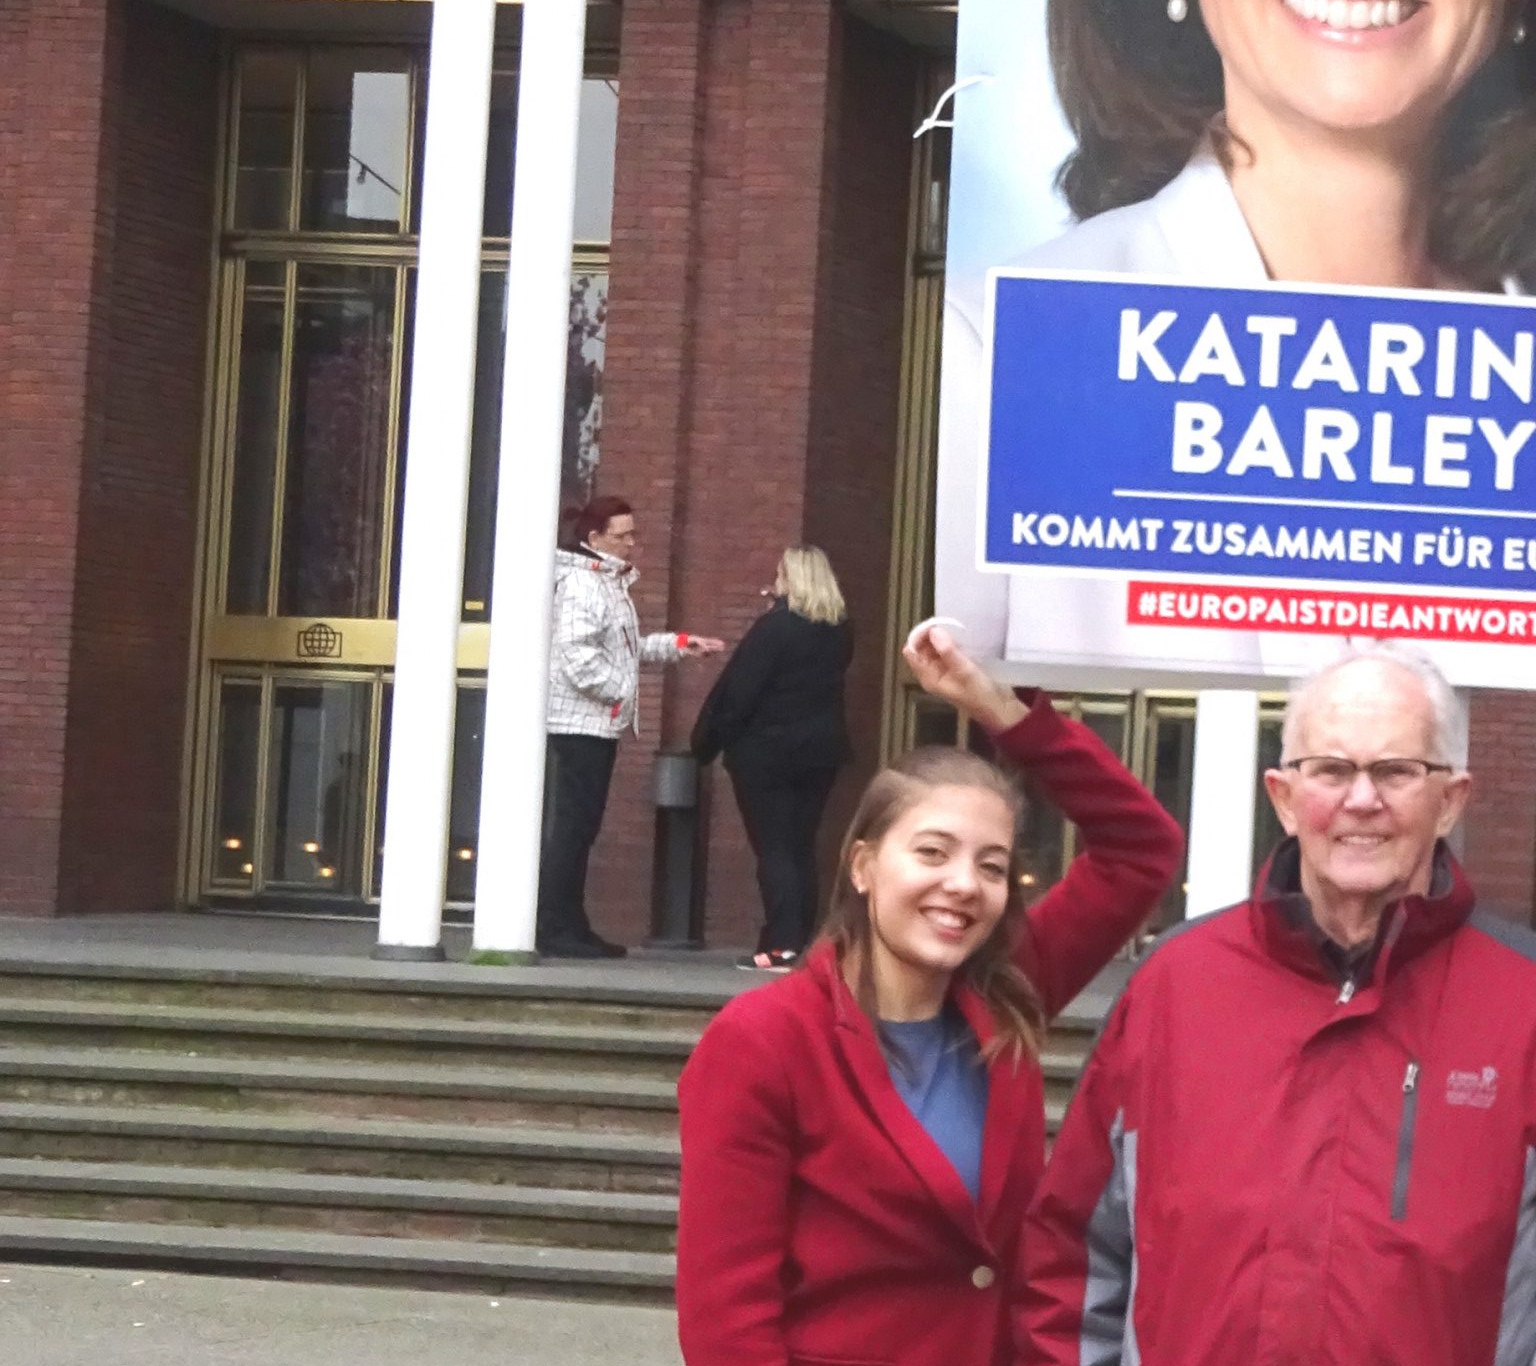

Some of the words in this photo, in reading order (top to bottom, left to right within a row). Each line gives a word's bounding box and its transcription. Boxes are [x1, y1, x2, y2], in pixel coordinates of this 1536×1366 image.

[1012, 512, 1164, 551] KOMMT
[1170, 520, 1403, 564] ZUSAMMEN
[1413, 526, 1493, 569] FÜR
